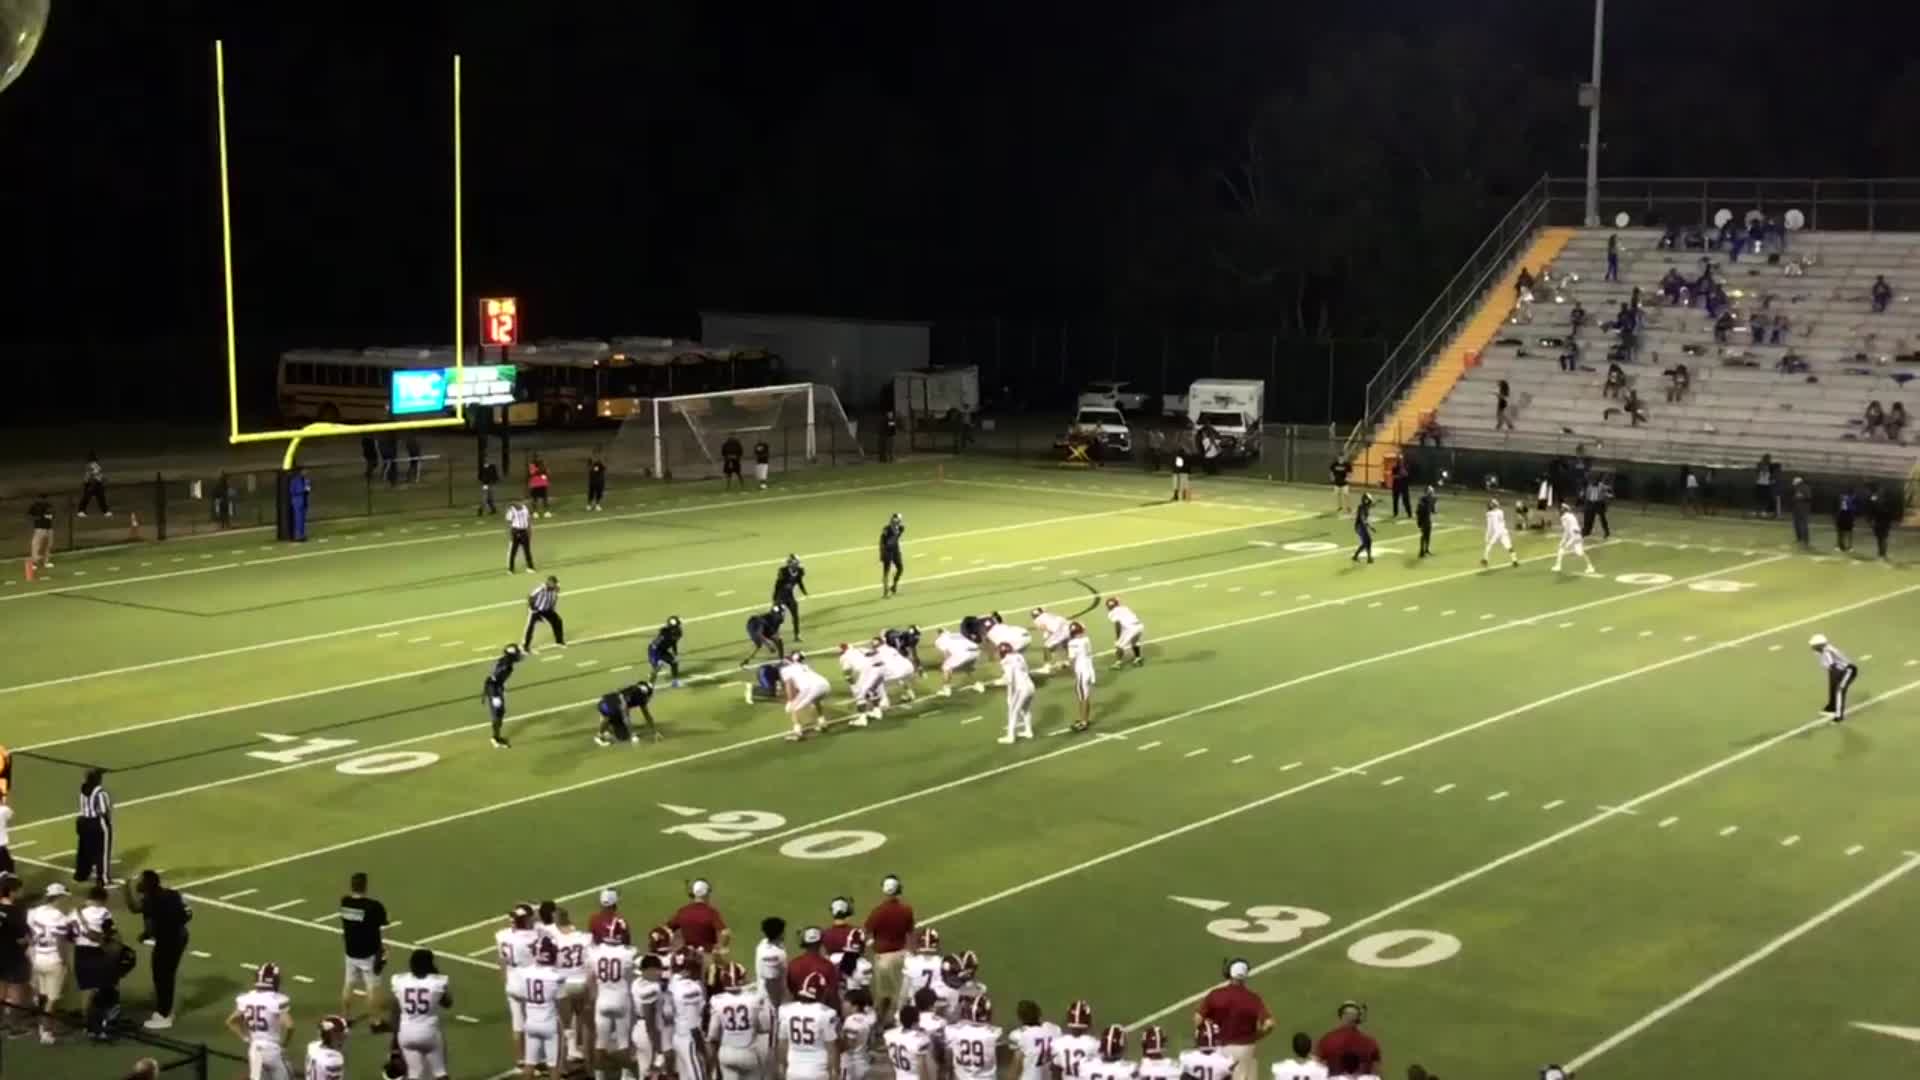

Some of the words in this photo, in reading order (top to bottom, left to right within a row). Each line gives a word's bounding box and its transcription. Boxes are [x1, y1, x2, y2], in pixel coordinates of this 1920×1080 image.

[491, 314, 512, 341] 12
[245, 737, 440, 775] 10
[659, 810, 888, 860] 20
[1206, 905, 1462, 968] 30
[560, 944, 584, 969] 37
[598, 957, 622, 983] 80
[525, 978, 545, 1005] 18
[922, 969, 935, 989] 7
[403, 988, 430, 1015] 55
[245, 1005, 268, 1033] 25
[722, 1004, 750, 1031] 33
[789, 1016, 815, 1046] 65
[888, 1042, 911, 1072] 36
[956, 1039, 985, 1068] 29
